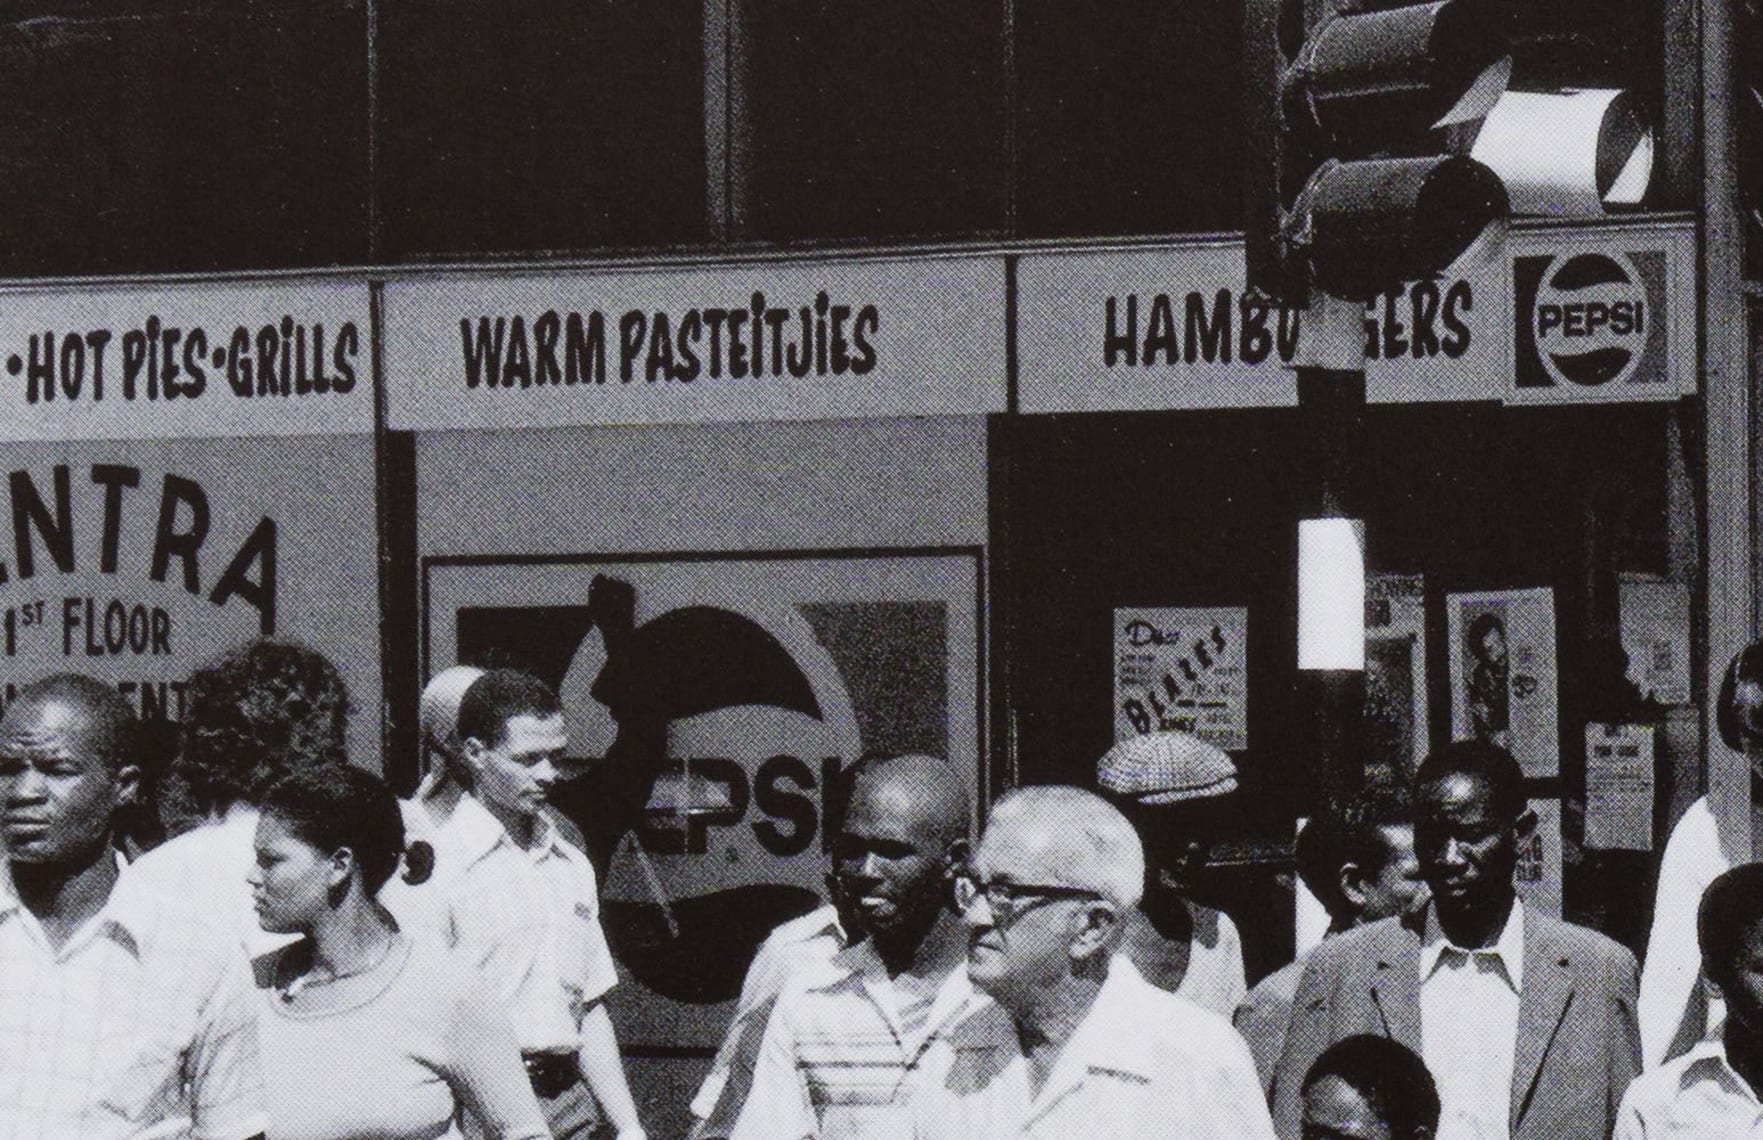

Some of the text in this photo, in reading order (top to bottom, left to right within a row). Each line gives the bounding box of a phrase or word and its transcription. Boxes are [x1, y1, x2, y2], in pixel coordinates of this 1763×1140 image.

[460, 309, 606, 389] WARM
[1538, 301, 1644, 338] PEPSI
[26, 330, 112, 404] HOT
[0, 463, 277, 636] NTRA
[62, 597, 172, 656] FLOOR
